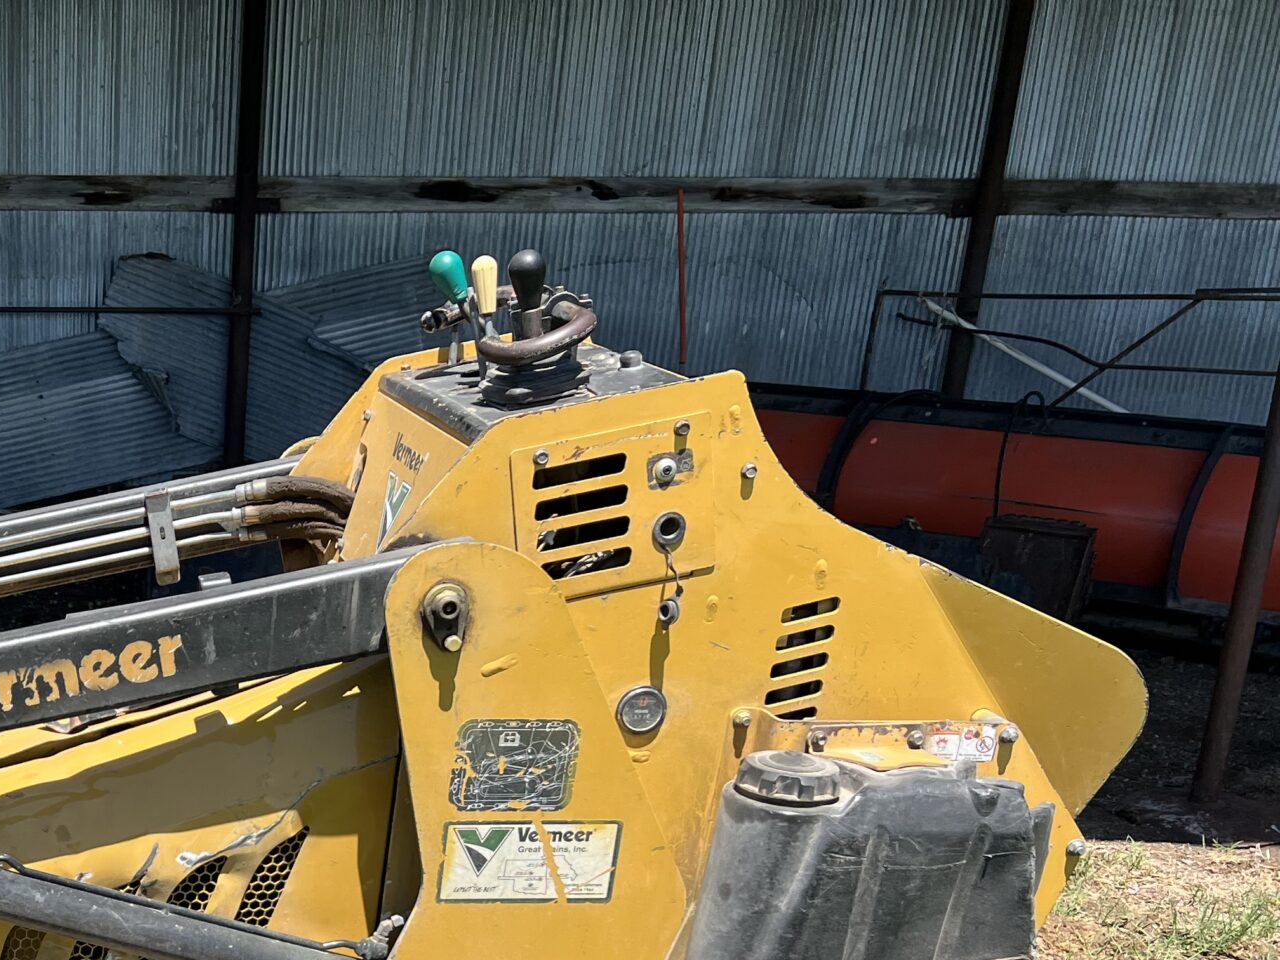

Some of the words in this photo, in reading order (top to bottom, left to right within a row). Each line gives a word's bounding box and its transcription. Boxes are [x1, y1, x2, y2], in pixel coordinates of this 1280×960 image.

[393, 432, 425, 473] Vermeer
[518, 827, 593, 843] Vemeer
[518, 846, 541, 854] Great
[573, 846, 589, 854] Inc.
